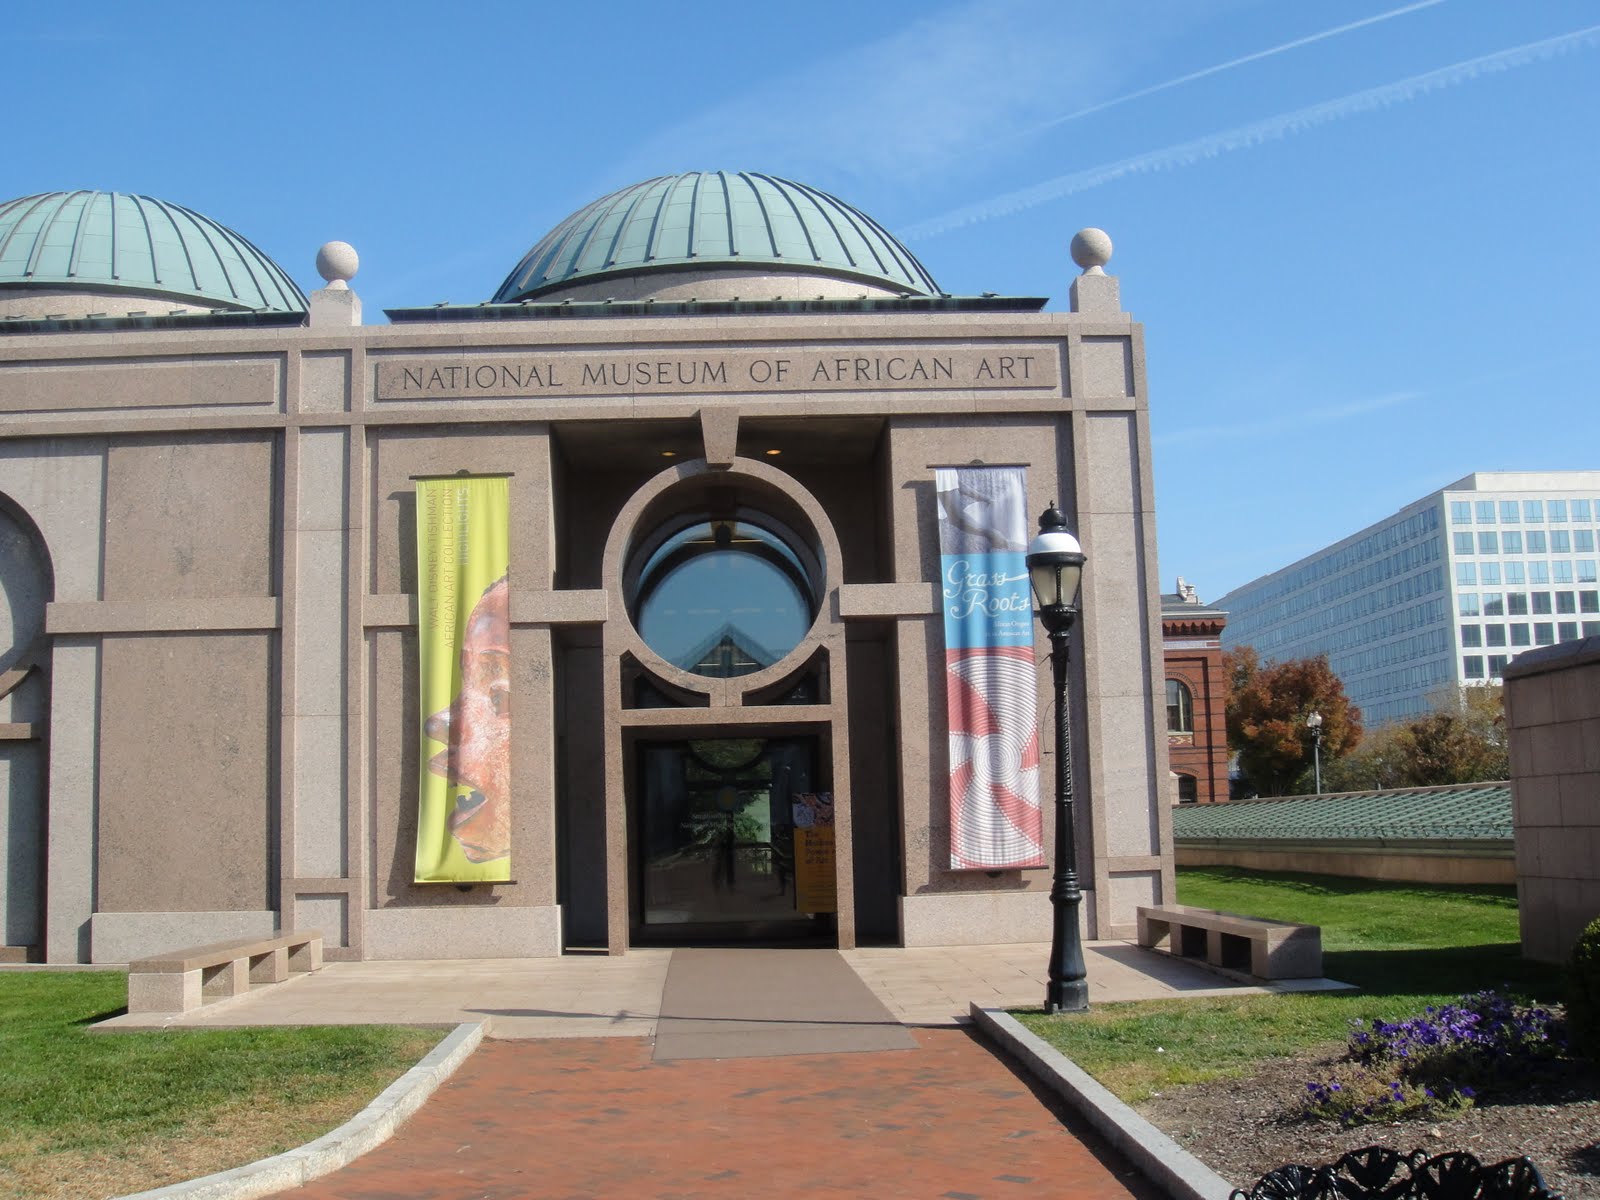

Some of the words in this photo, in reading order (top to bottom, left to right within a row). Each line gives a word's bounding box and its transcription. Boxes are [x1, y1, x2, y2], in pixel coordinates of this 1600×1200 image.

[403, 363, 563, 390] NATIONAL
[582, 361, 727, 387] MUSEUM
[749, 360, 791, 384] OF
[811, 357, 953, 382] AFRICAN
[975, 356, 1035, 380] ART
[443, 488, 454, 564] COLLECTION
[443, 568, 455, 592] ART
[950, 588, 1030, 619] Roots
[444, 595, 455, 649] AFRICAN
